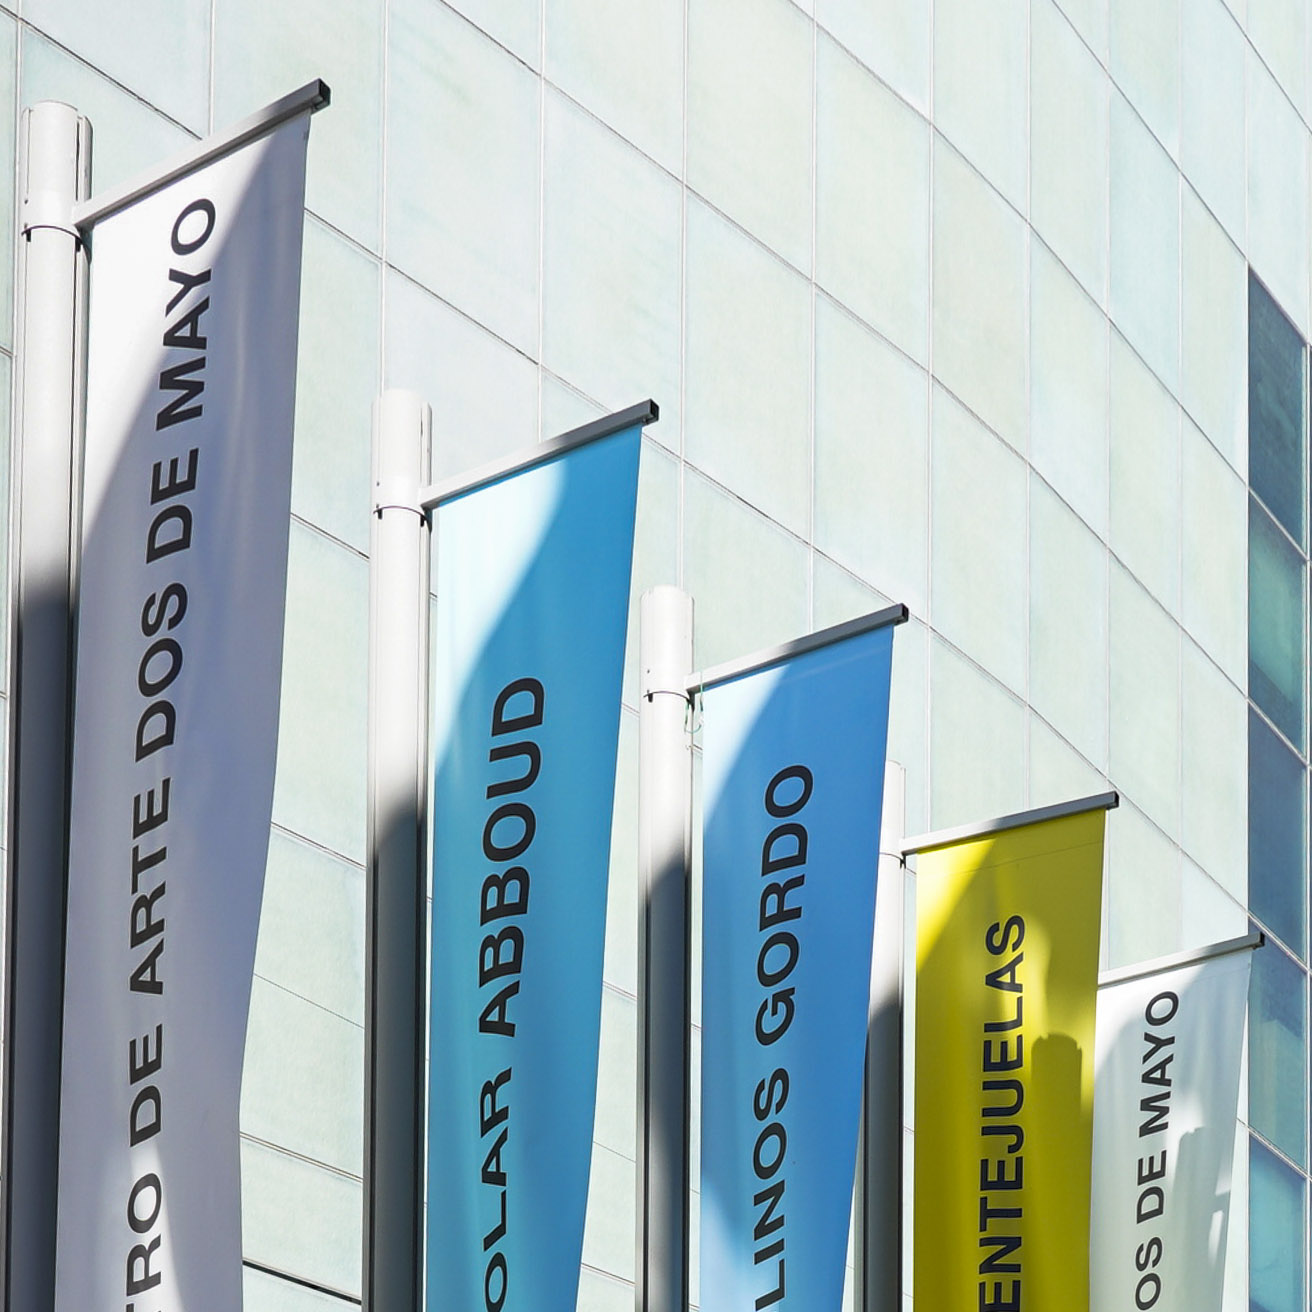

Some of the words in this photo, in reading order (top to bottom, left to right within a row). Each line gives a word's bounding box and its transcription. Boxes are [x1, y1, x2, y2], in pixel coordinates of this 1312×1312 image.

[154, 198, 218, 433] MAYO
[145, 446, 200, 567] DE
[134, 581, 189, 760] DOS
[128, 776, 172, 996] ARTE
[477, 676, 546, 1039] ABBOUD
[754, 764, 815, 1047] GORDO
[128, 1022, 164, 1149] DE
[1137, 990, 1181, 1139] MAYO
[1135, 1149, 1168, 1225] DE
